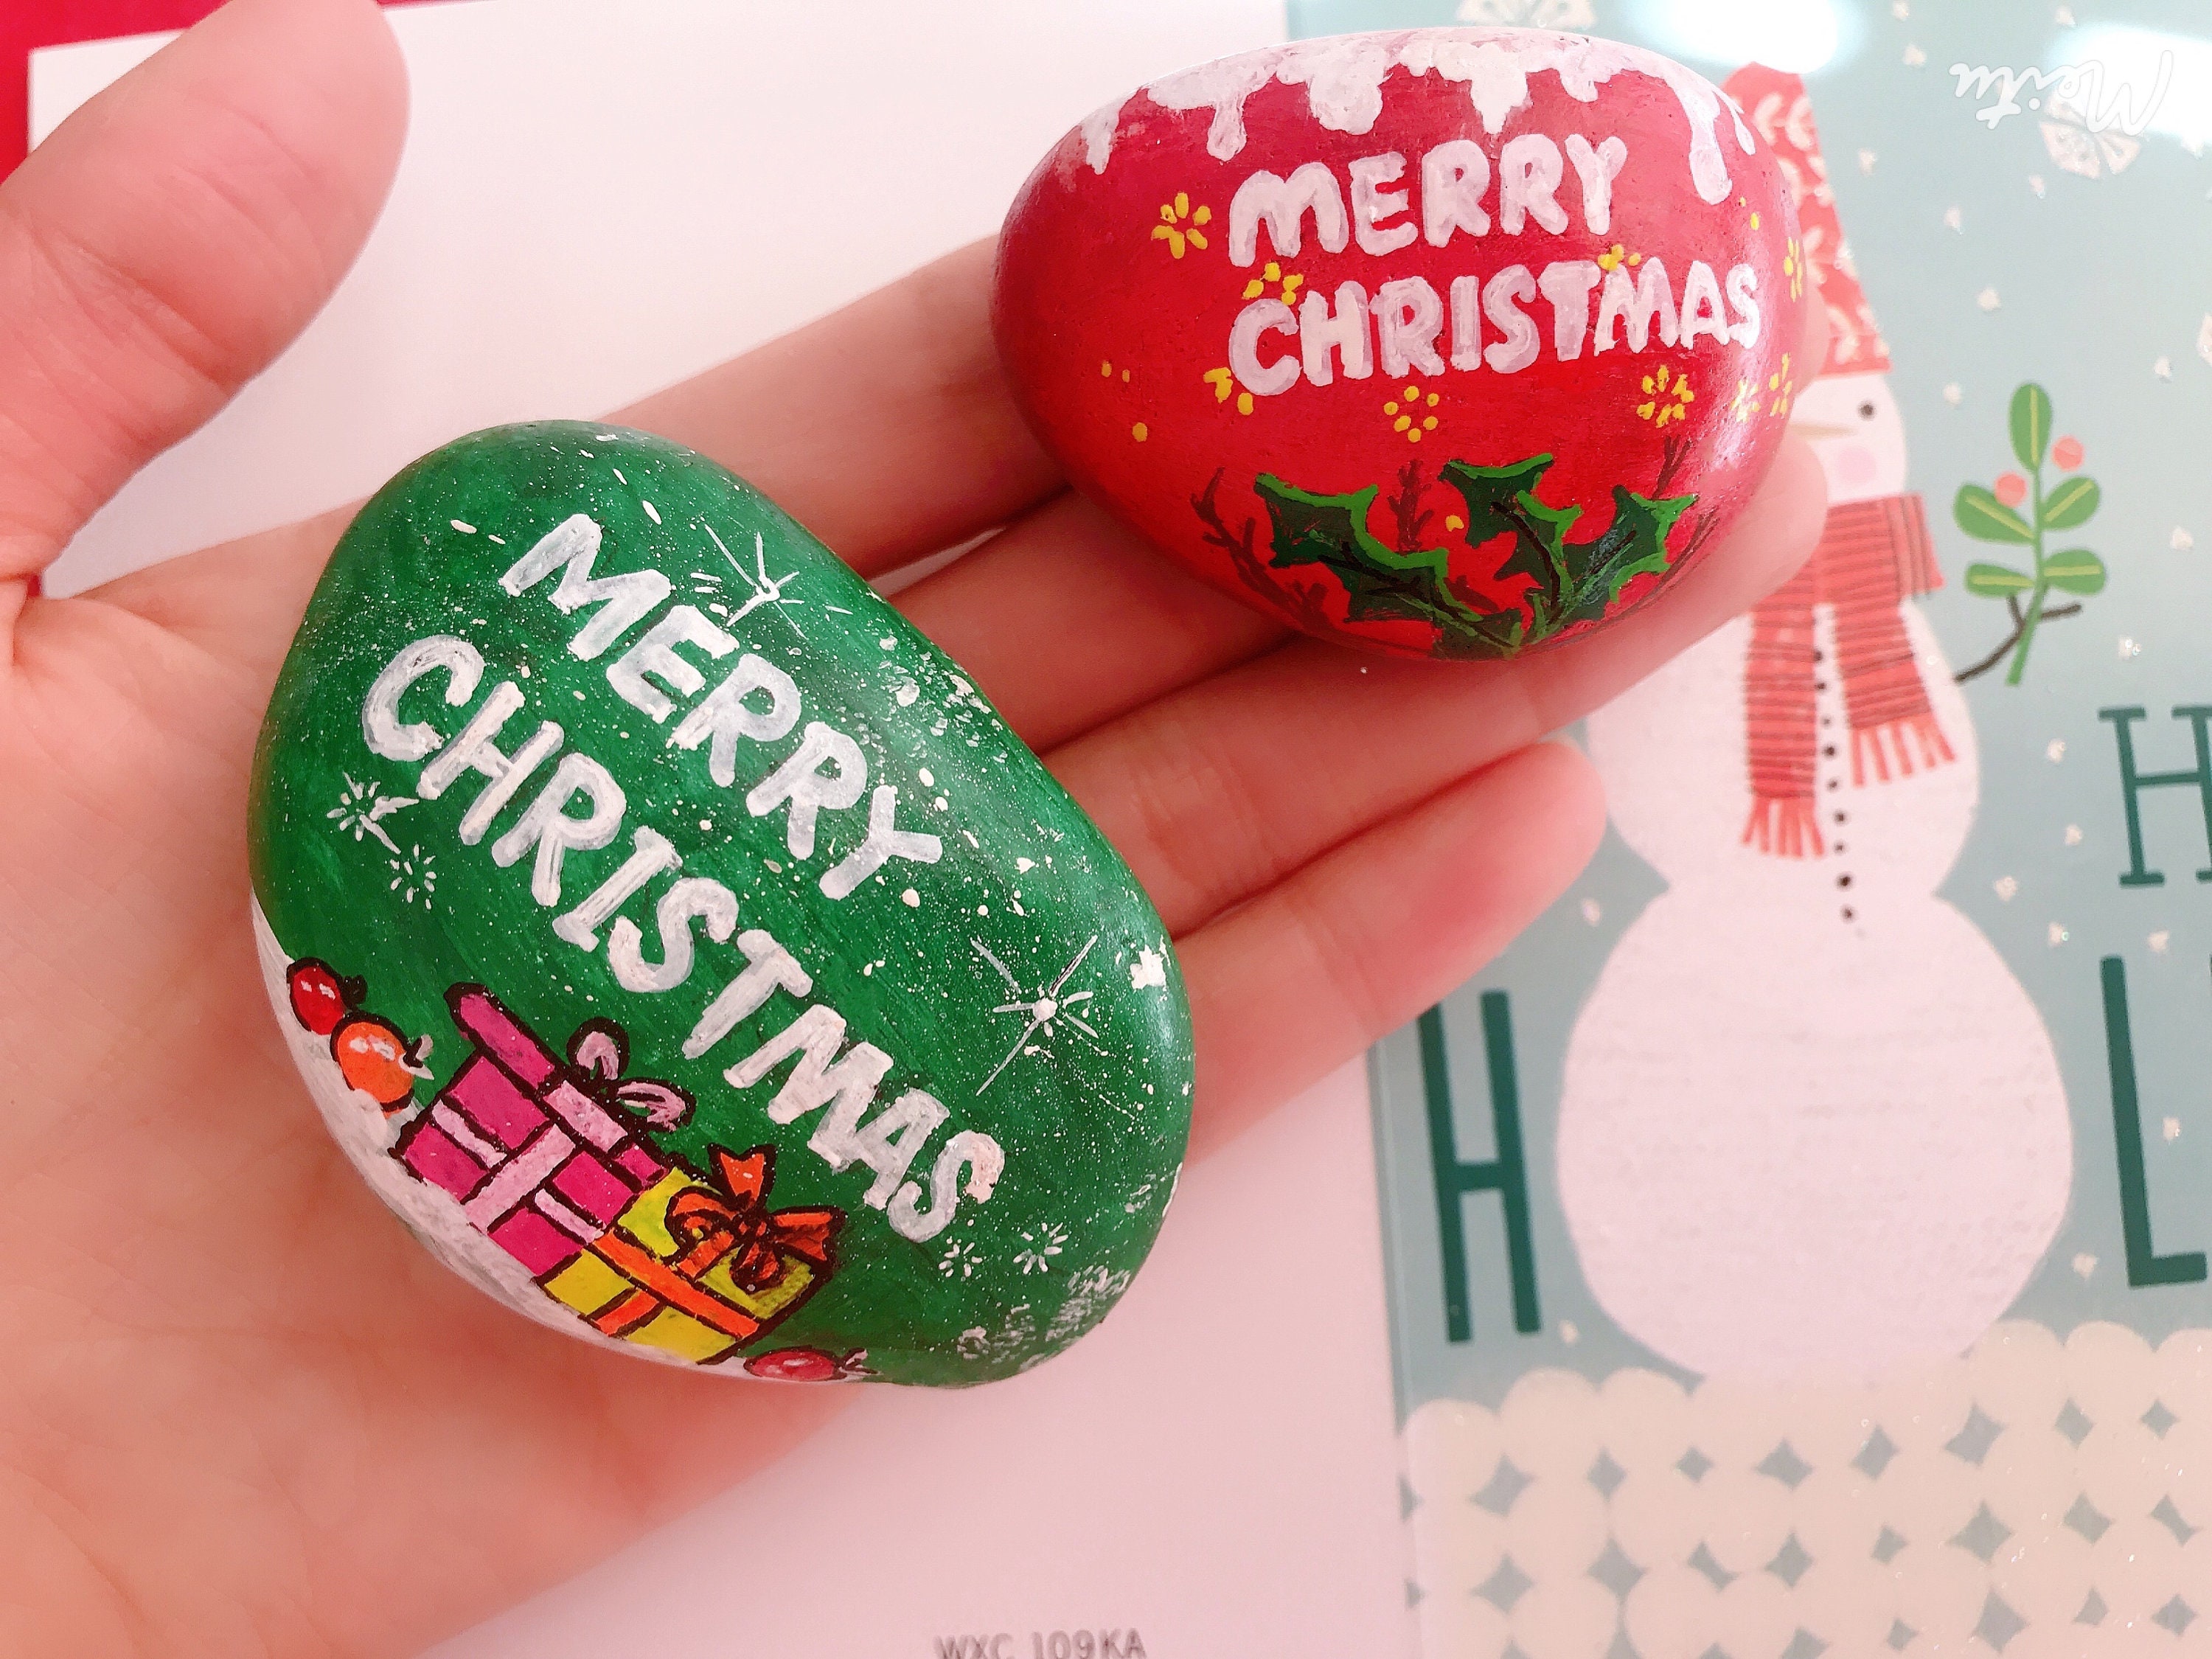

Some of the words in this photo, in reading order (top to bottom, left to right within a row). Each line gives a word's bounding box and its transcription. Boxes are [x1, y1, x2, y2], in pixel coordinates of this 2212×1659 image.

[1228, 133, 1628, 268] MERRY
[1228, 256, 1761, 397] CHRISTMAS
[498, 513, 943, 900] MERRY
[362, 634, 1004, 1242] CHRISTMAS
